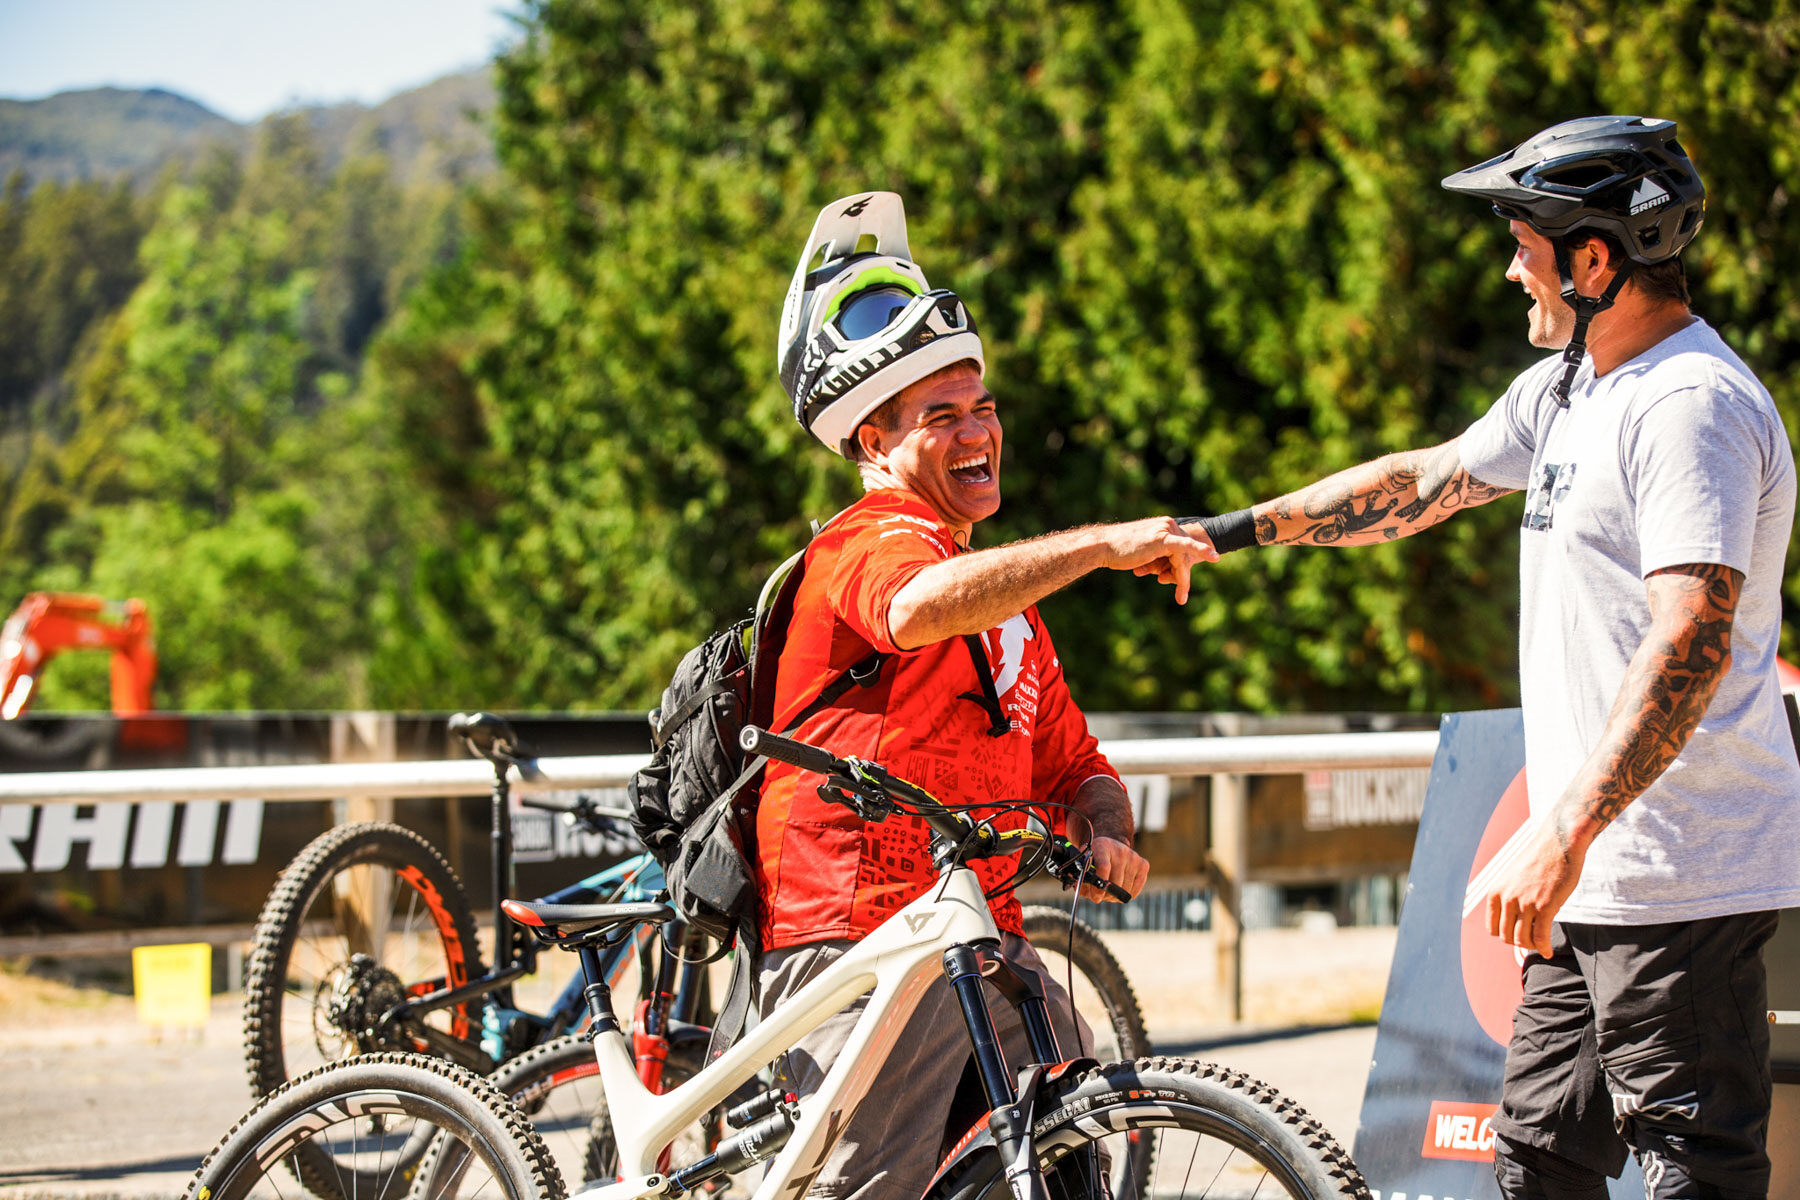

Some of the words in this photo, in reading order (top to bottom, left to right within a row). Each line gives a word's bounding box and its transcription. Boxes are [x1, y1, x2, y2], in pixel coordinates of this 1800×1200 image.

[1630, 194, 1670, 216] SRAM
[1033, 1096, 1092, 1139] SSEGAI
[1435, 1114, 1497, 1152] WELC
